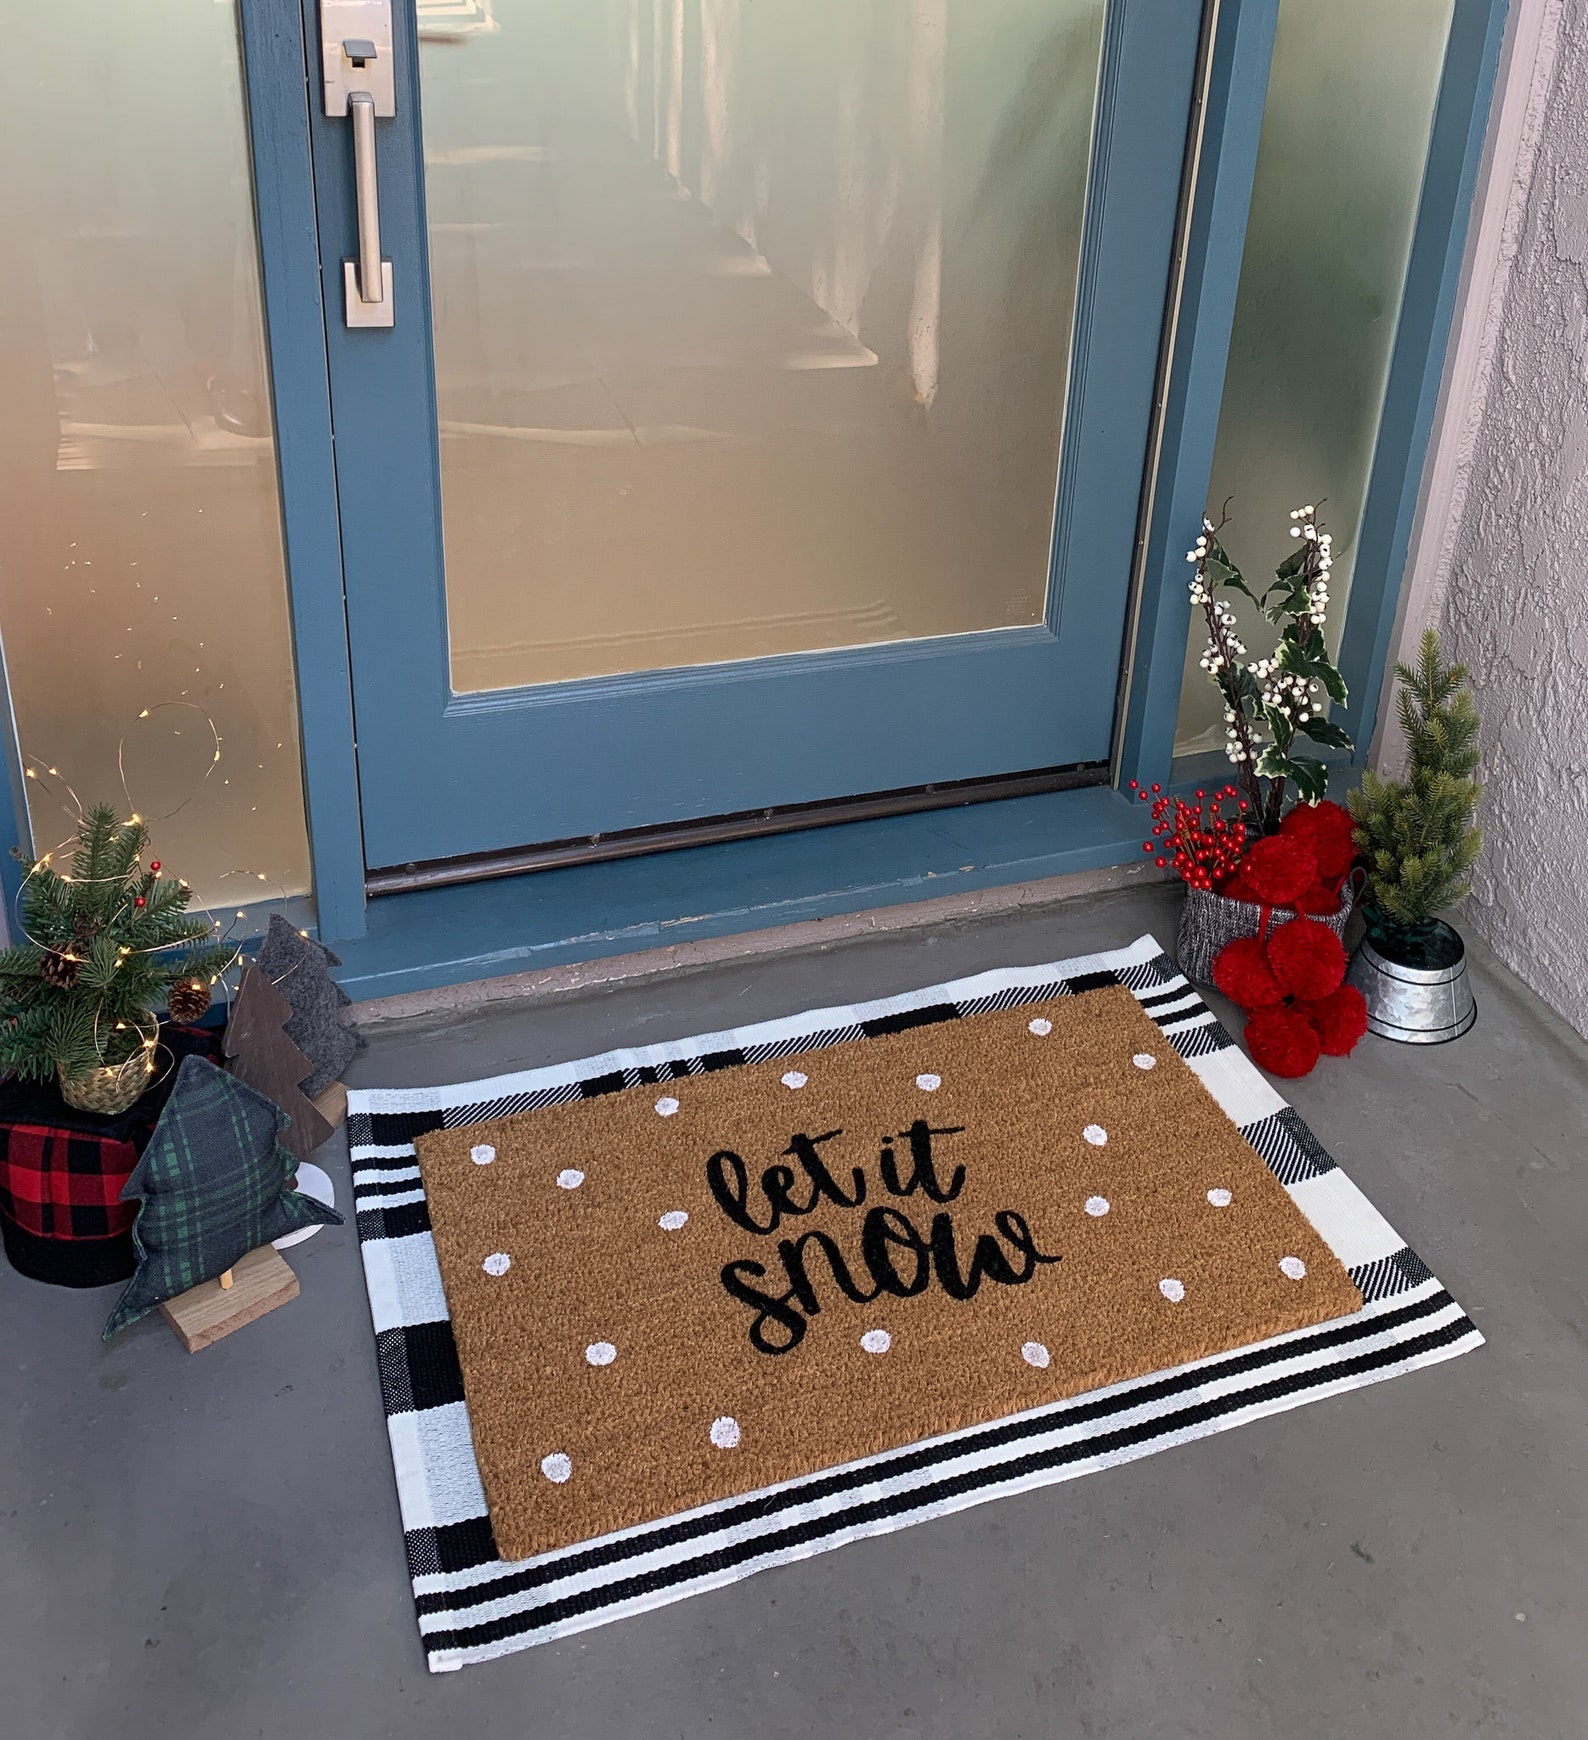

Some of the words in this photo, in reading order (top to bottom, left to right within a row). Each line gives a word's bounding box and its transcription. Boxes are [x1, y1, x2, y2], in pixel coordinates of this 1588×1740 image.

[706, 1128, 867, 1236] let
[880, 1119, 966, 1205] it
[719, 1206, 1063, 1357] snow
